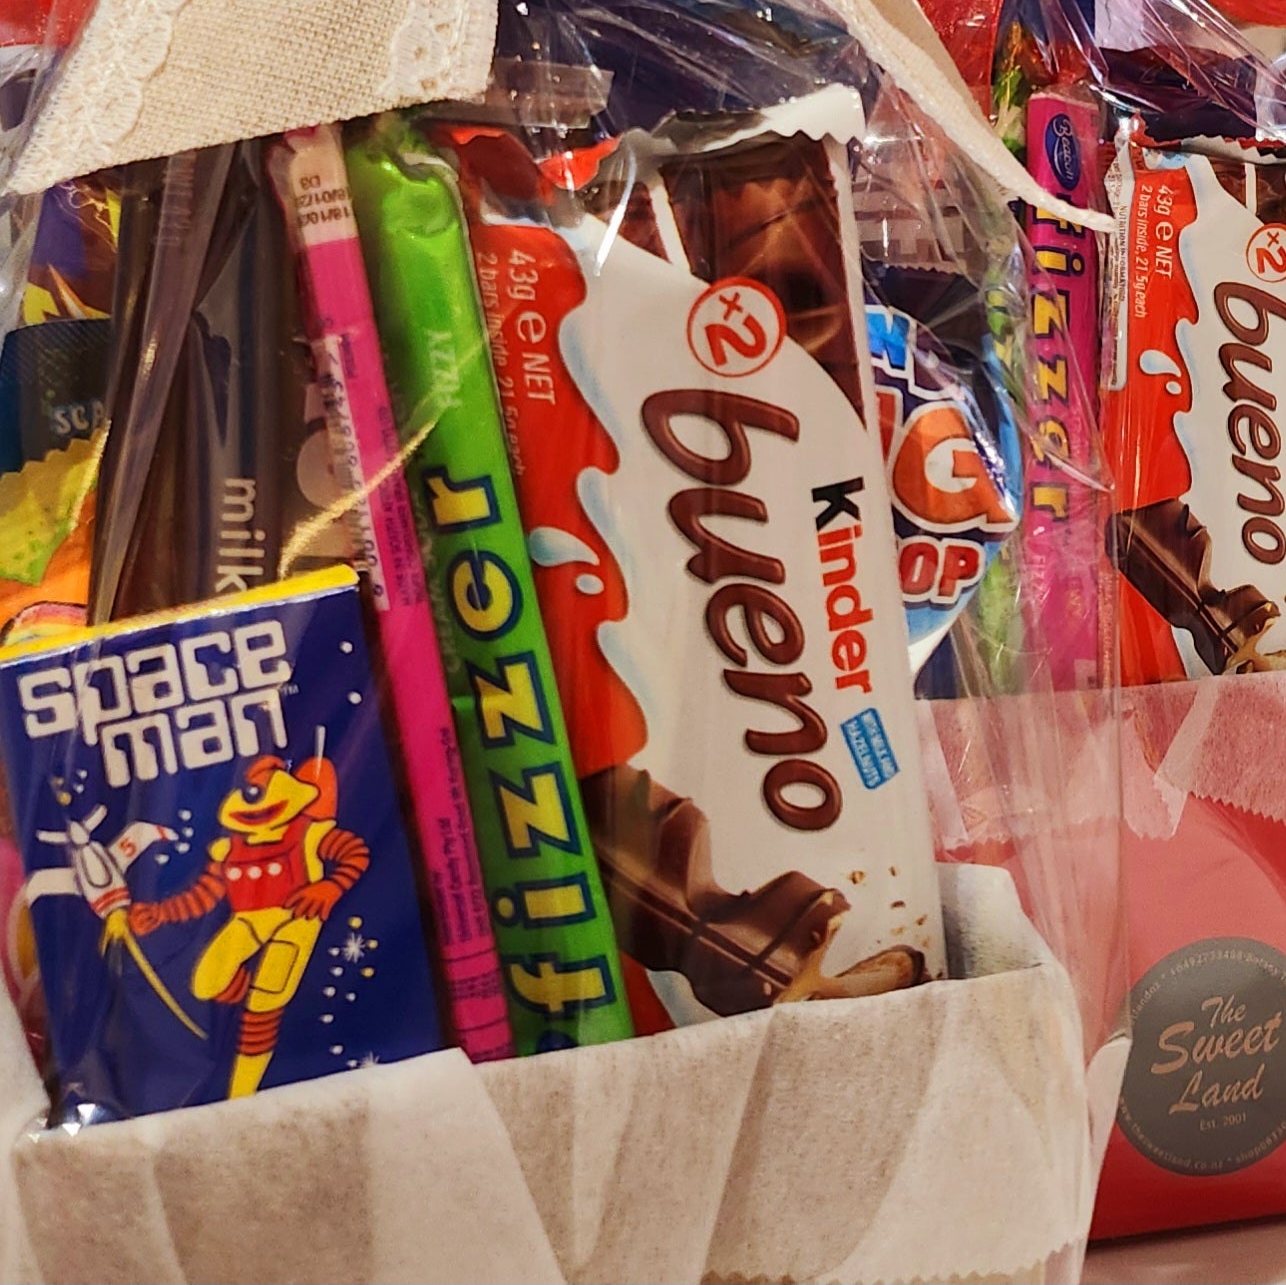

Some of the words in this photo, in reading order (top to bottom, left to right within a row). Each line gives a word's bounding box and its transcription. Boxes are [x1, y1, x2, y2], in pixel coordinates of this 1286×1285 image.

[1053, 119, 1074, 179] Beacon
[1137, 194, 1150, 217] bars
[1154, 185, 1173, 215] 43g
[480, 268, 500, 308] bars
[507, 250, 538, 300] 43g
[1155, 246, 1172, 280] NET
[1134, 292, 1147, 318] each
[521, 352, 555, 405] NET
[215, 476, 267, 592] milk
[811, 476, 875, 695] Kinder
[899, 536, 987, 606] OP
[641, 387, 844, 831] bueno
[18, 619, 291, 747] space
[101, 688, 288, 789] man
[423, 466, 616, 1014] fizzer
[1200, 993, 1247, 1028] The
[1150, 1011, 1283, 1075] Sweet
[1168, 1063, 1266, 1115] Land
